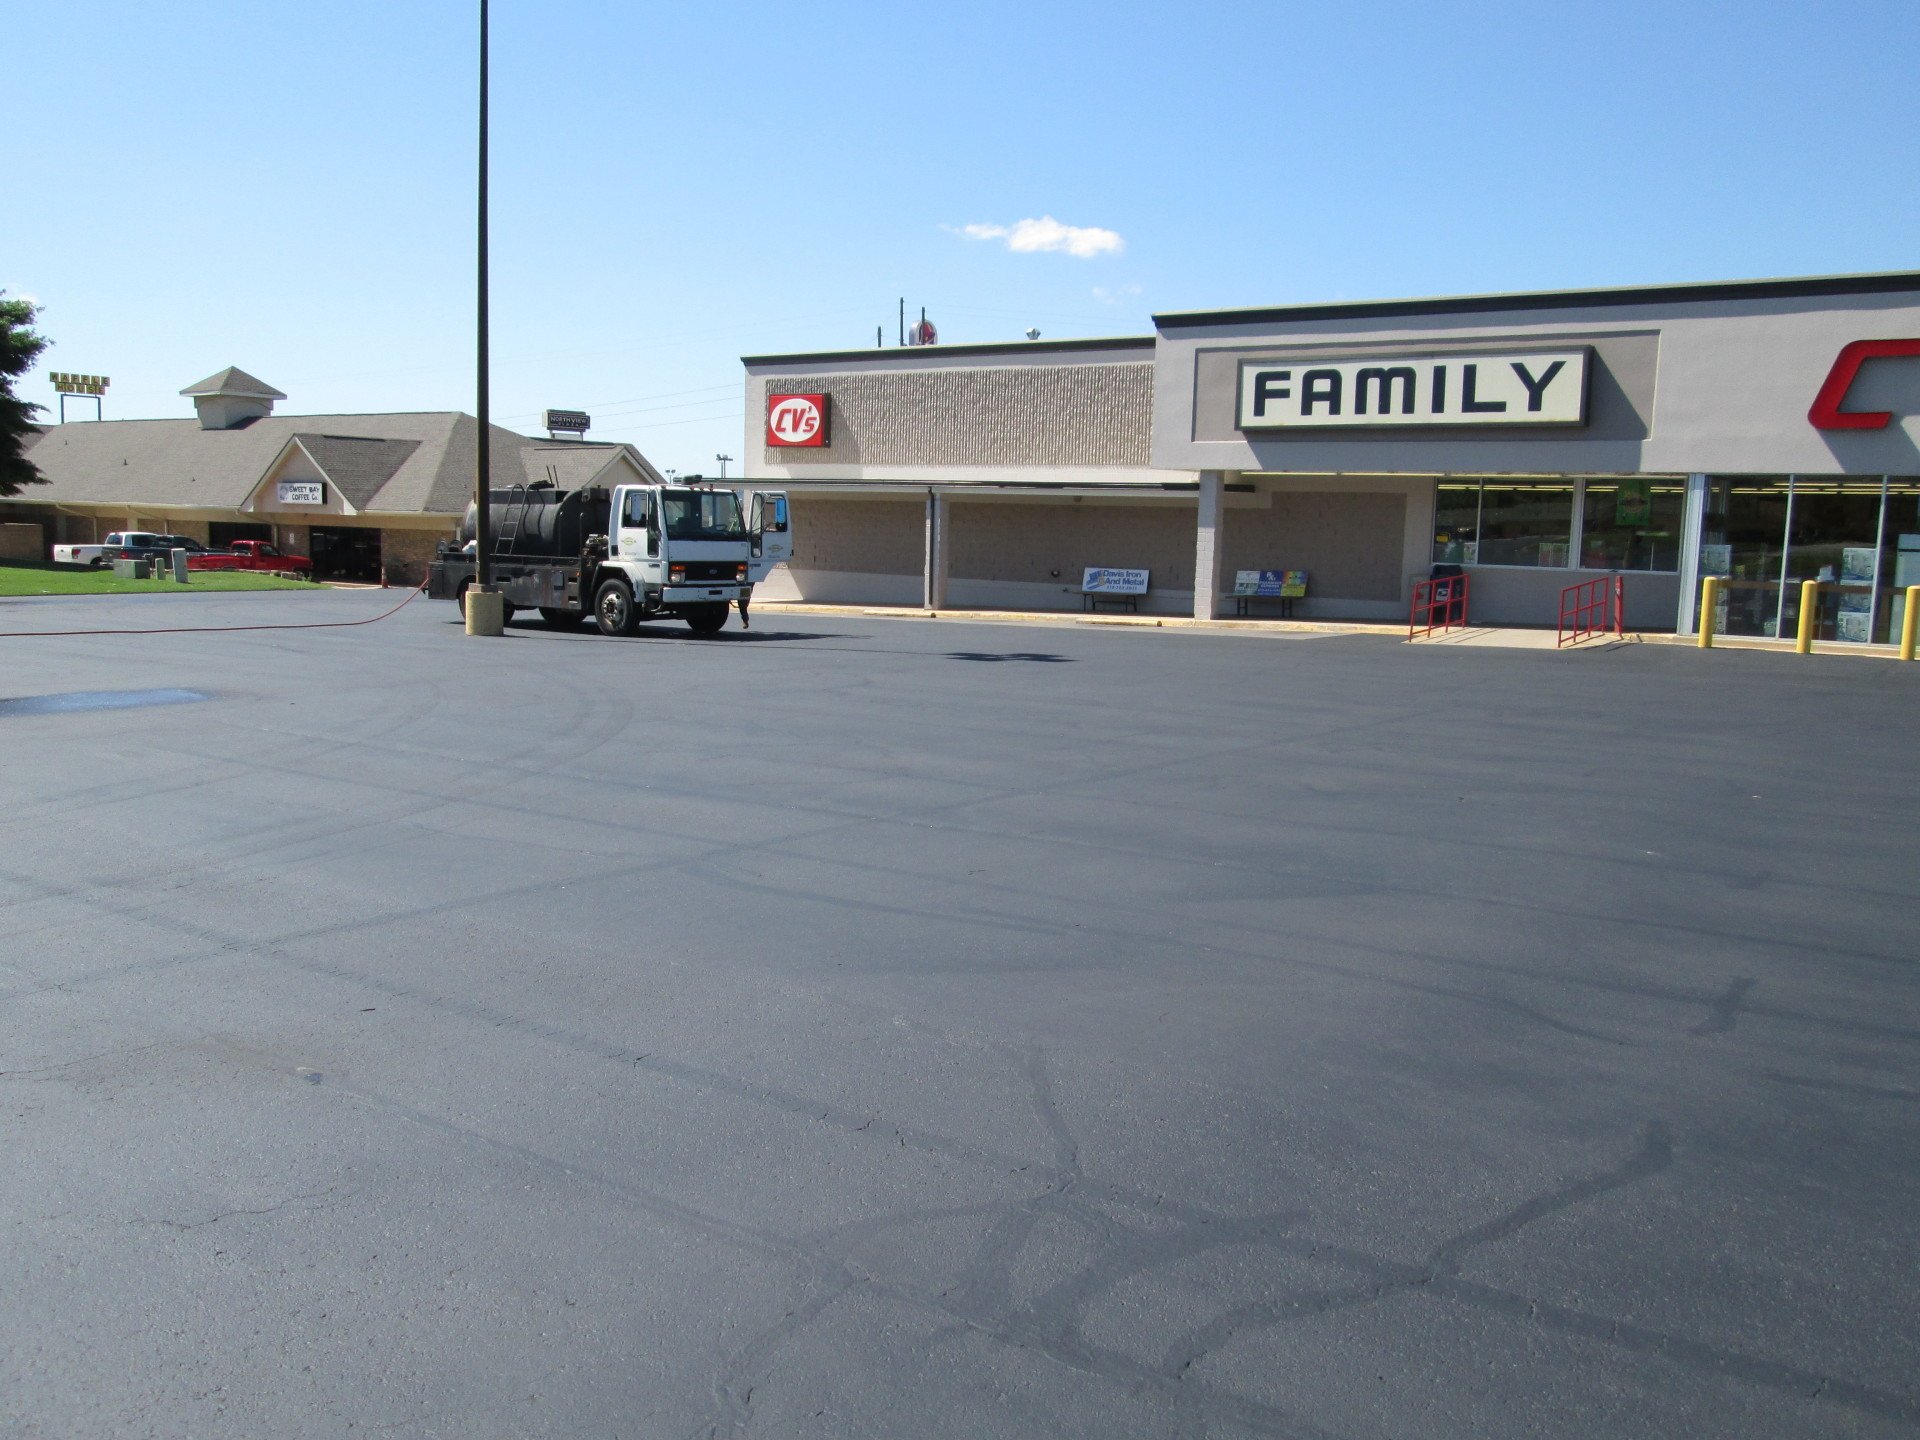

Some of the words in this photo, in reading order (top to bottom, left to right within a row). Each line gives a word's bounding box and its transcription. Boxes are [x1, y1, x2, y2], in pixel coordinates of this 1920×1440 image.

[51, 373, 109, 386] WAFFLE
[57, 383, 104, 394] HOUSE
[1253, 360, 1567, 417] FAMILY
[775, 405, 817, 433] CV's
[292, 493, 310, 501] COFFEE
[1103, 570, 1125, 578] Davis
[1105, 577, 1121, 585] And
[1122, 578, 1144, 586] Metal
